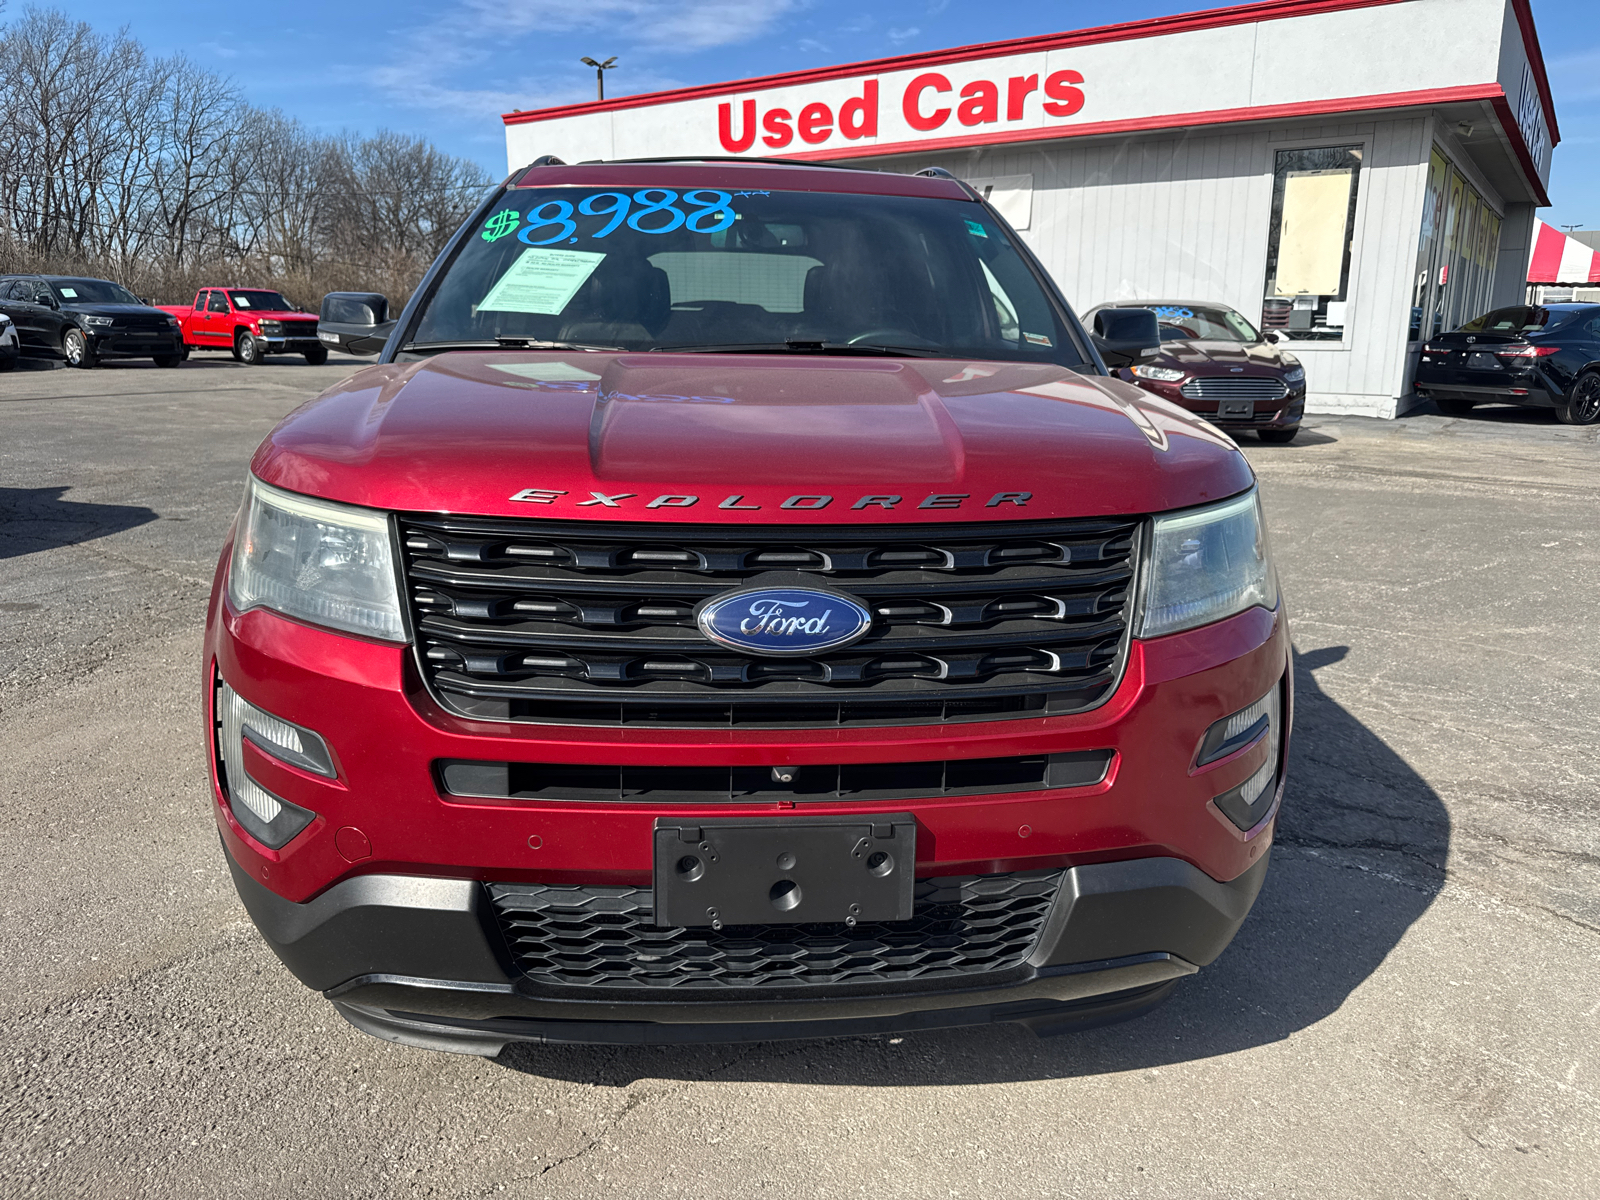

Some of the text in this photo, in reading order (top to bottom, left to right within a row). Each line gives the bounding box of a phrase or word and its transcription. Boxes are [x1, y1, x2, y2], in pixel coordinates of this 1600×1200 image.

[718, 69, 1085, 153] Used Cars
[508, 490, 1033, 511] EXPLORER
[740, 599, 832, 636] Ford
